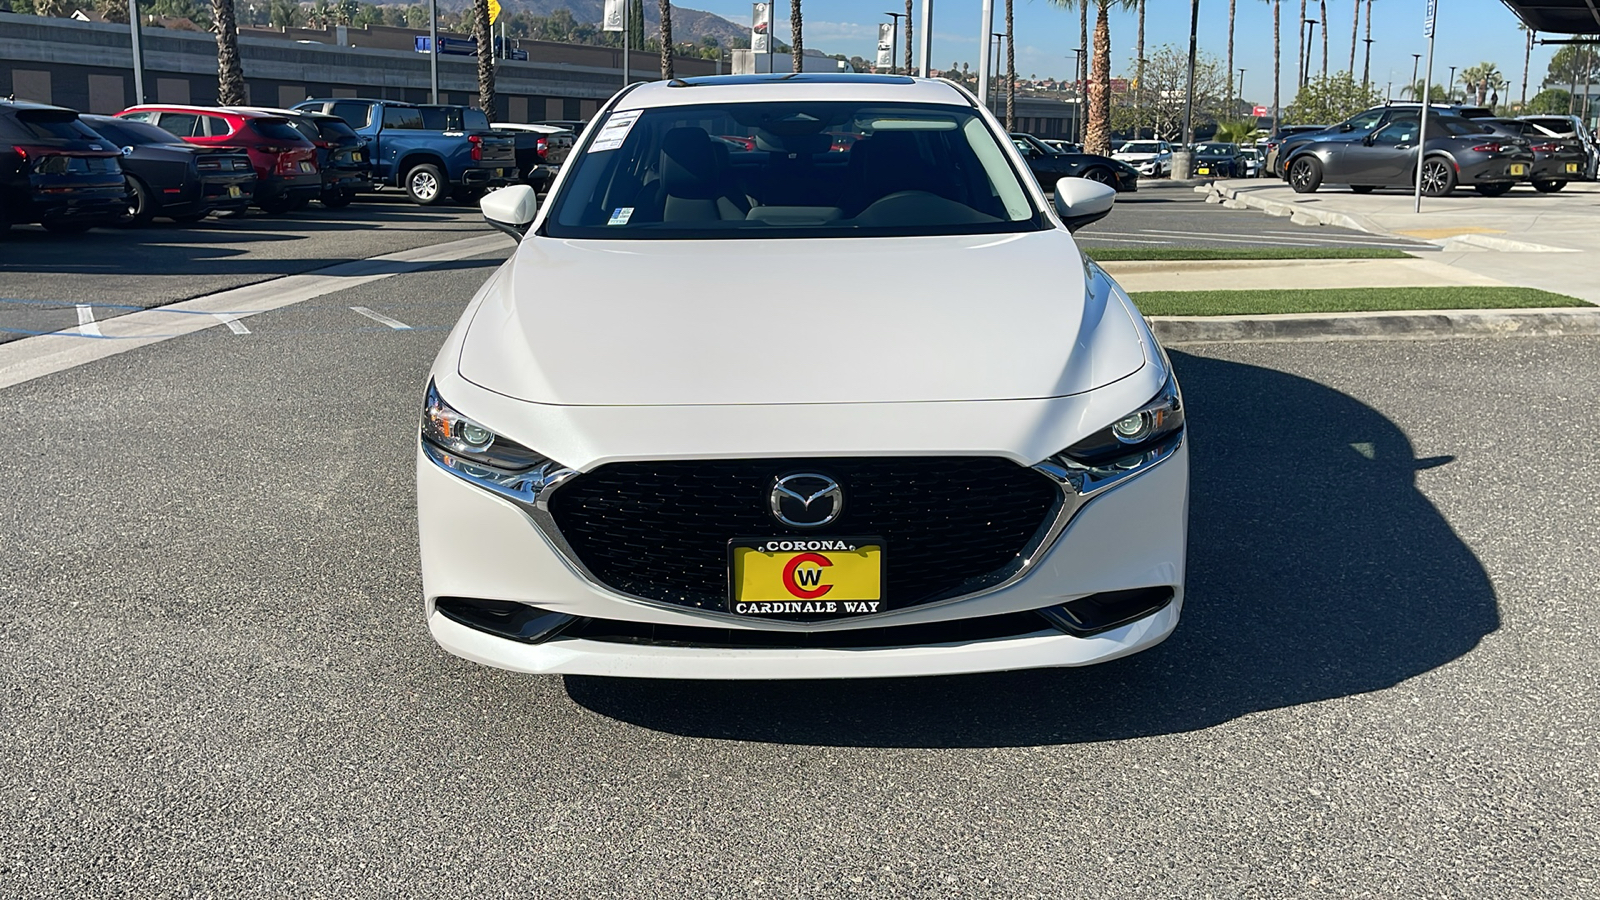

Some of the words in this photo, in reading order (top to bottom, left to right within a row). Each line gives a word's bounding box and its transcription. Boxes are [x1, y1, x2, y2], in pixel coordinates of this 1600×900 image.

[766, 540, 848, 551] CORONA
[735, 602, 837, 614] CARDINALE
[843, 601, 880, 613] WAY
